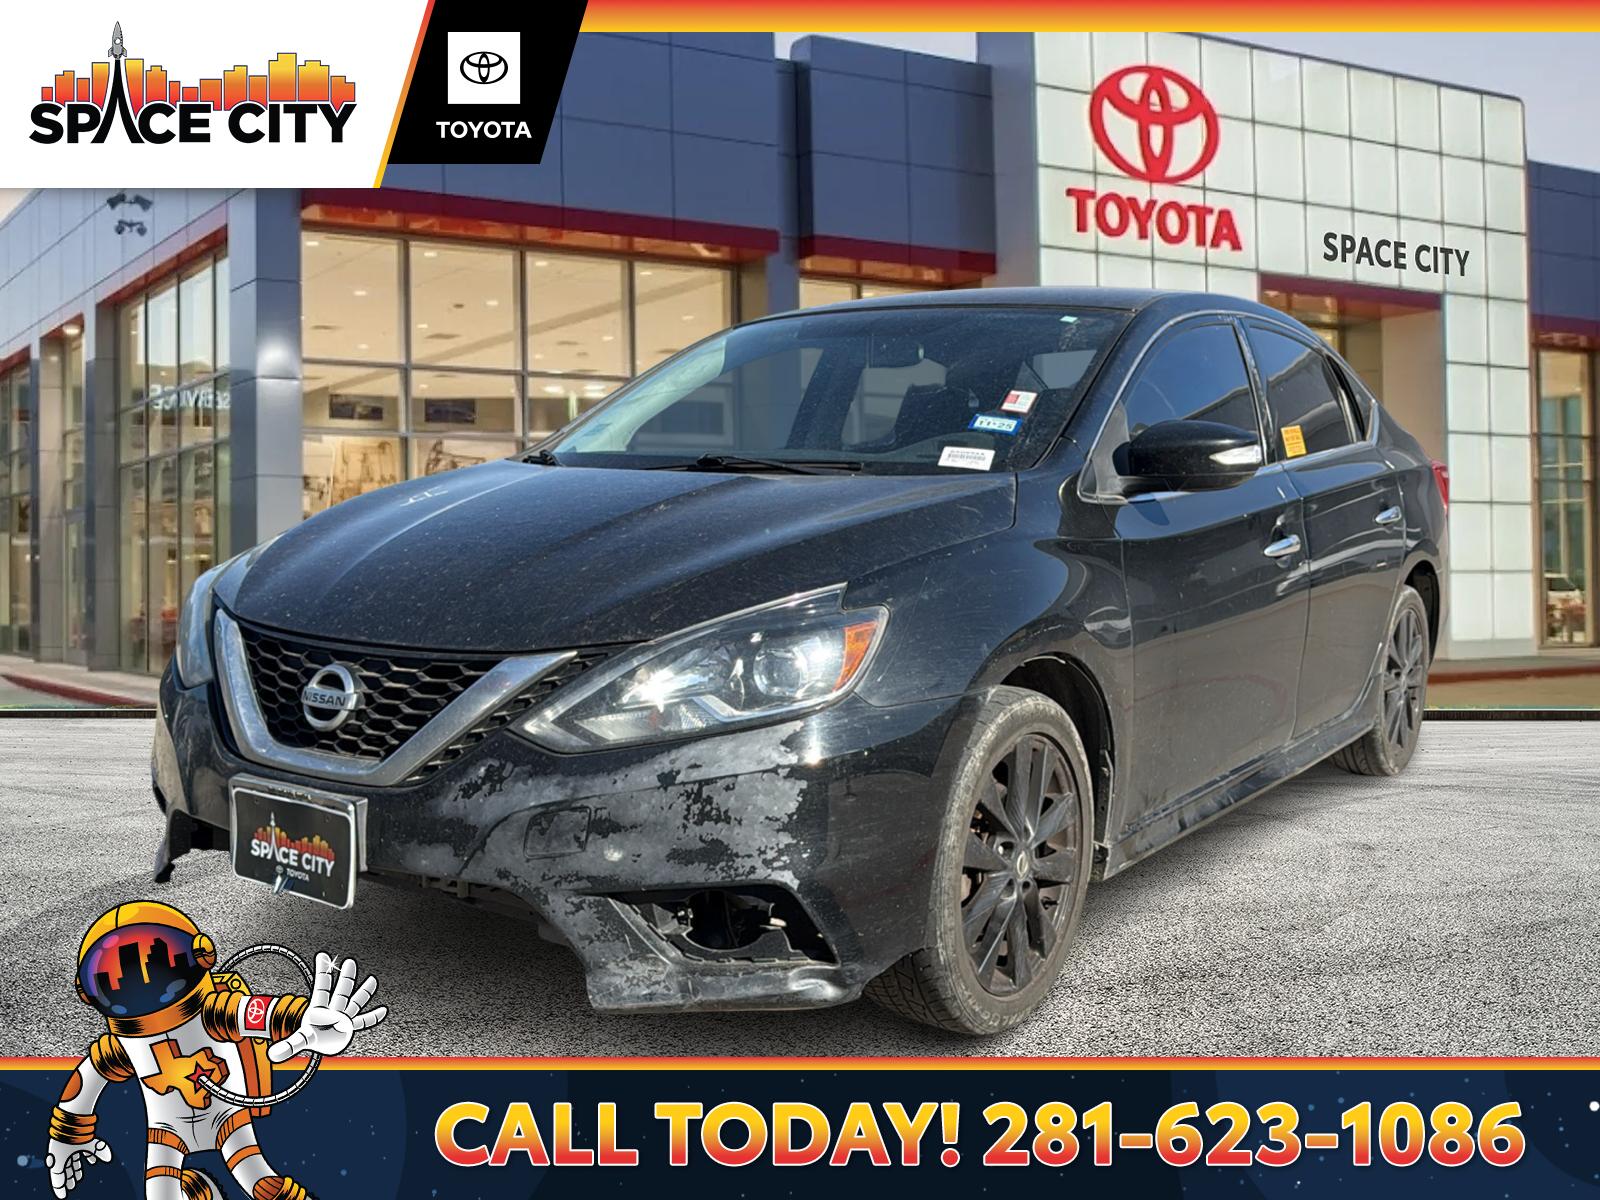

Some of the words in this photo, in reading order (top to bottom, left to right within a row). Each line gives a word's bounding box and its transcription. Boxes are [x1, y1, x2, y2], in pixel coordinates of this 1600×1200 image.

[1067, 188, 1242, 250] TOYOTA
[1323, 232, 1407, 270] SPACE
[1415, 244, 1471, 276] CITY
[303, 690, 346, 706] NISSAN
[251, 838, 299, 867] SPACE
[301, 852, 335, 877] CITY
[286, 867, 310, 882] TOYOTA
